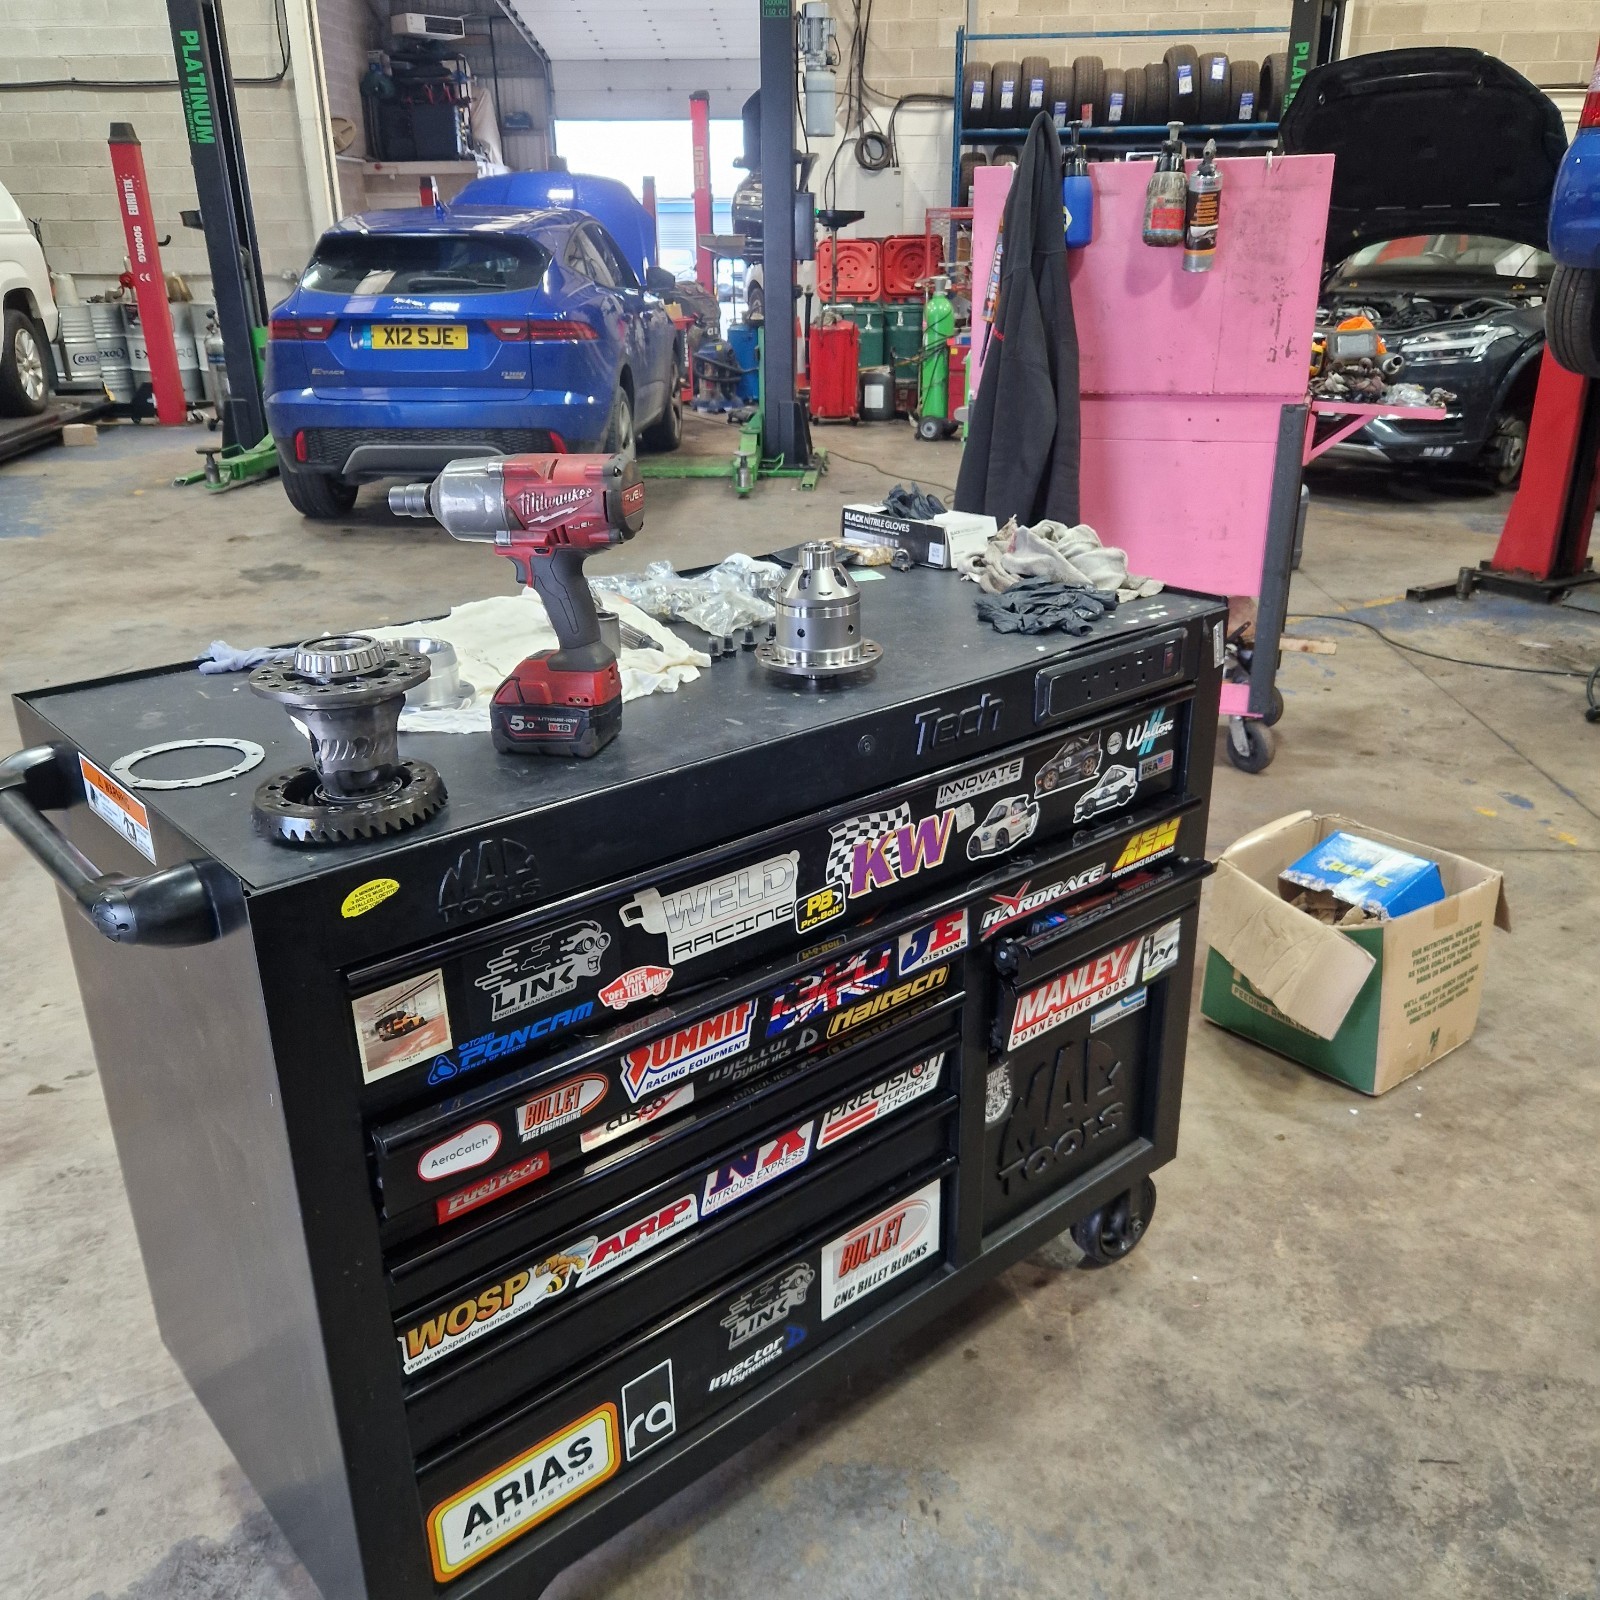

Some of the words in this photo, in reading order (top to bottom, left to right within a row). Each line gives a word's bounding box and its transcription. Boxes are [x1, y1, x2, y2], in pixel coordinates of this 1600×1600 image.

[180, 30, 215, 143] PLATINUM
[133, 225, 147, 263] 5000KG
[384, 327, 414, 345] X12
[418, 327, 454, 345] SJE
[519, 488, 593, 516] Milwaukee
[844, 511, 865, 523] BLACK
[863, 516, 885, 528] NITRILE
[884, 519, 910, 533] GLOVES
[549, 723, 571, 732] M18
[914, 693, 1005, 756] Tech
[1126, 718, 1174, 750] Walton
[938, 774, 1019, 805] MOTORSPORTS
[940, 761, 1021, 799] INNOVATE
[849, 808, 955, 899] KW
[1112, 817, 1181, 871] AEM
[661, 858, 795, 934] WELD
[801, 904, 841, 930] Pro-Bolt
[806, 889, 834, 917] PB
[982, 866, 1107, 930] HARDRACE
[673, 901, 794, 960] RACING
[900, 909, 964, 972] JE
[920, 940, 967, 965] PISTONS
[493, 1004, 523, 1020] ENGINE
[523, 984, 576, 1008] MANAGEMENT
[494, 963, 576, 1013] LINK
[621, 969, 648, 987] VANS
[626, 981, 646, 999] THE
[830, 966, 948, 1036] Haltech
[1016, 943, 1133, 1028] MANLEY
[1233, 986, 1269, 1013] FEEDING
[458, 1001, 594, 1068] PONCAM
[1011, 997, 1092, 1047] CONNECTING
[1097, 977, 1128, 1001] RODS
[468, 1031, 495, 1047] TOMEI
[629, 1002, 751, 1087] SUMMIT
[645, 1066, 686, 1091] RACING
[688, 1038, 748, 1071] EQUIPMENT
[459, 1057, 488, 1073] POWER
[827, 1053, 941, 1124] PRECISION
[880, 1077, 924, 1104] TURBO
[926, 1071, 936, 1081] &
[524, 1083, 585, 1131] BULLET
[877, 1080, 933, 1115] ENGINE
[522, 1129, 540, 1143] RACE
[540, 1110, 582, 1136] ENGINEERING
[431, 1137, 489, 1170] AeroCatch
[705, 1174, 754, 1208] NITROUS
[756, 1147, 806, 1180] EXPRESS
[709, 1127, 807, 1197] NX
[585, 1246, 634, 1276] automotive
[657, 1213, 692, 1237] products
[587, 1198, 692, 1269] ARP
[838, 1212, 906, 1278] BULLET
[833, 1285, 856, 1309] CNC
[857, 1265, 889, 1295] BILLET
[890, 1242, 928, 1273] BLOCKS
[407, 1271, 531, 1361] WOSP
[407, 1300, 532, 1371] www.wosperformance.com
[731, 1297, 789, 1342] LINK
[730, 1346, 783, 1386] Dynamics
[462, 1436, 594, 1541] ARIAS
[463, 1509, 522, 1550] RACING
[531, 1462, 596, 1507] PISTONS
